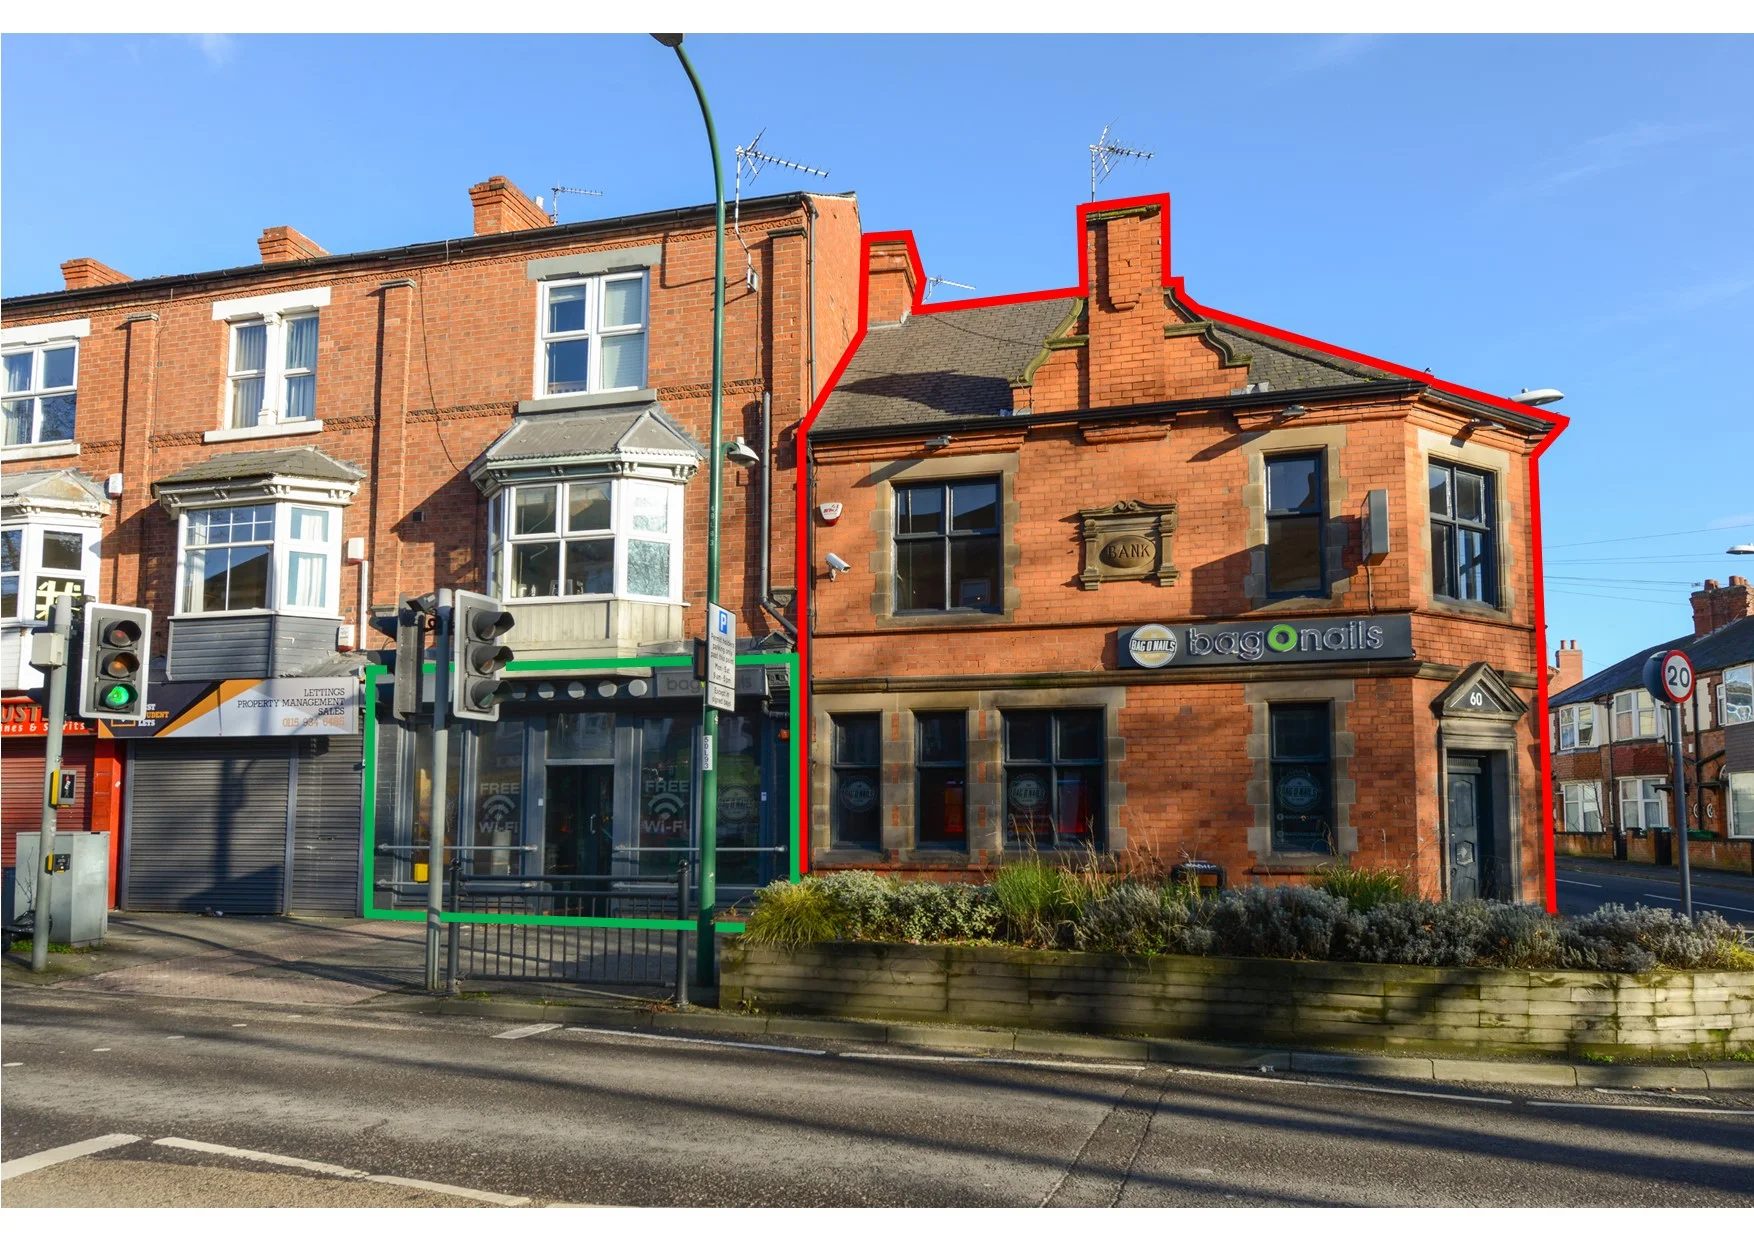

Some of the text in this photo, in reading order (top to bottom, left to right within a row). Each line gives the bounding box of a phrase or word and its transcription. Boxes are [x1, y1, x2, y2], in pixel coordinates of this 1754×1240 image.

[1107, 544, 1150, 558] BANK
[1131, 640, 1146, 652] BAG
[1153, 640, 1176, 652] NAILS
[1667, 665, 1690, 688] 20
[304, 688, 345, 697] LETTINGS
[237, 697, 345, 708] PROPERTY MANAGEMENT
[1470, 692, 1483, 706] 60
[318, 707, 345, 716] SALES
[138, 719, 156, 727] LETS
[480, 783, 520, 795] FREE
[645, 780, 690, 793] FREE
